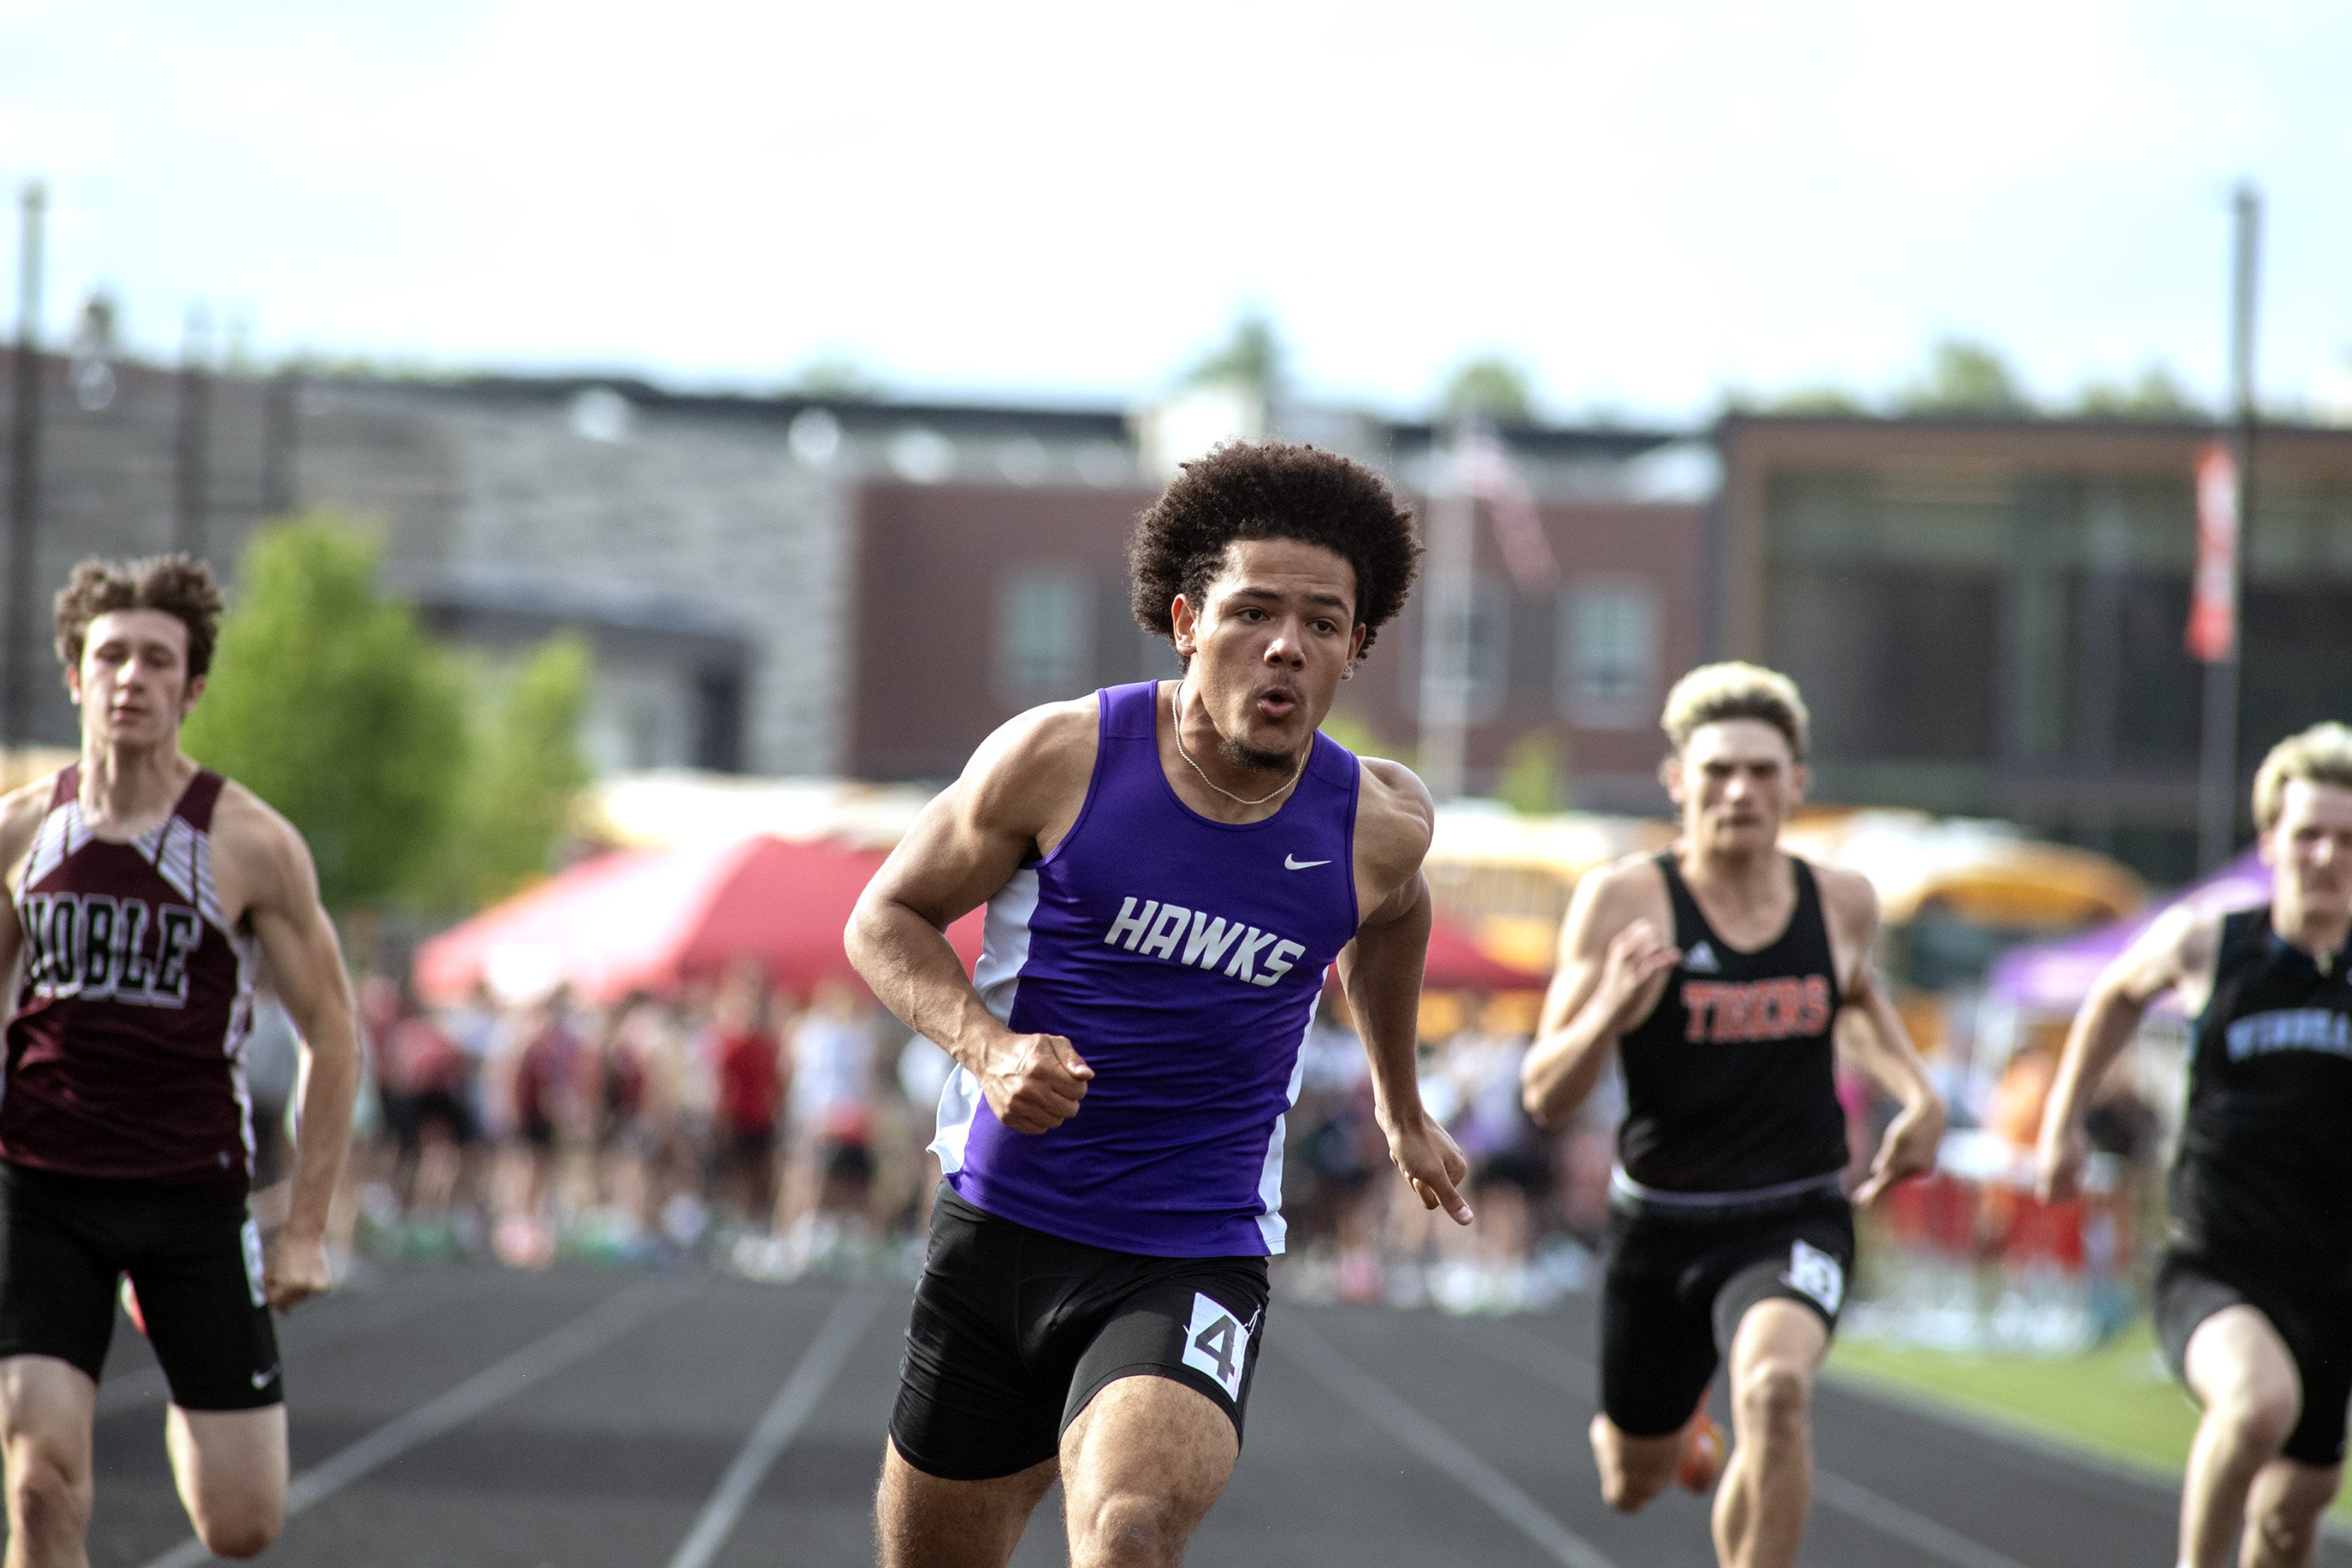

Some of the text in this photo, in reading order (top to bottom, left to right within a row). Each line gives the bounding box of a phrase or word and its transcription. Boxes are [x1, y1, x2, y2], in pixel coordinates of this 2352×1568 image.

[1104, 896, 1306, 987] HAWKS
[1681, 975, 1829, 1043] TIGERS
[1194, 1314, 1238, 1385] 4
